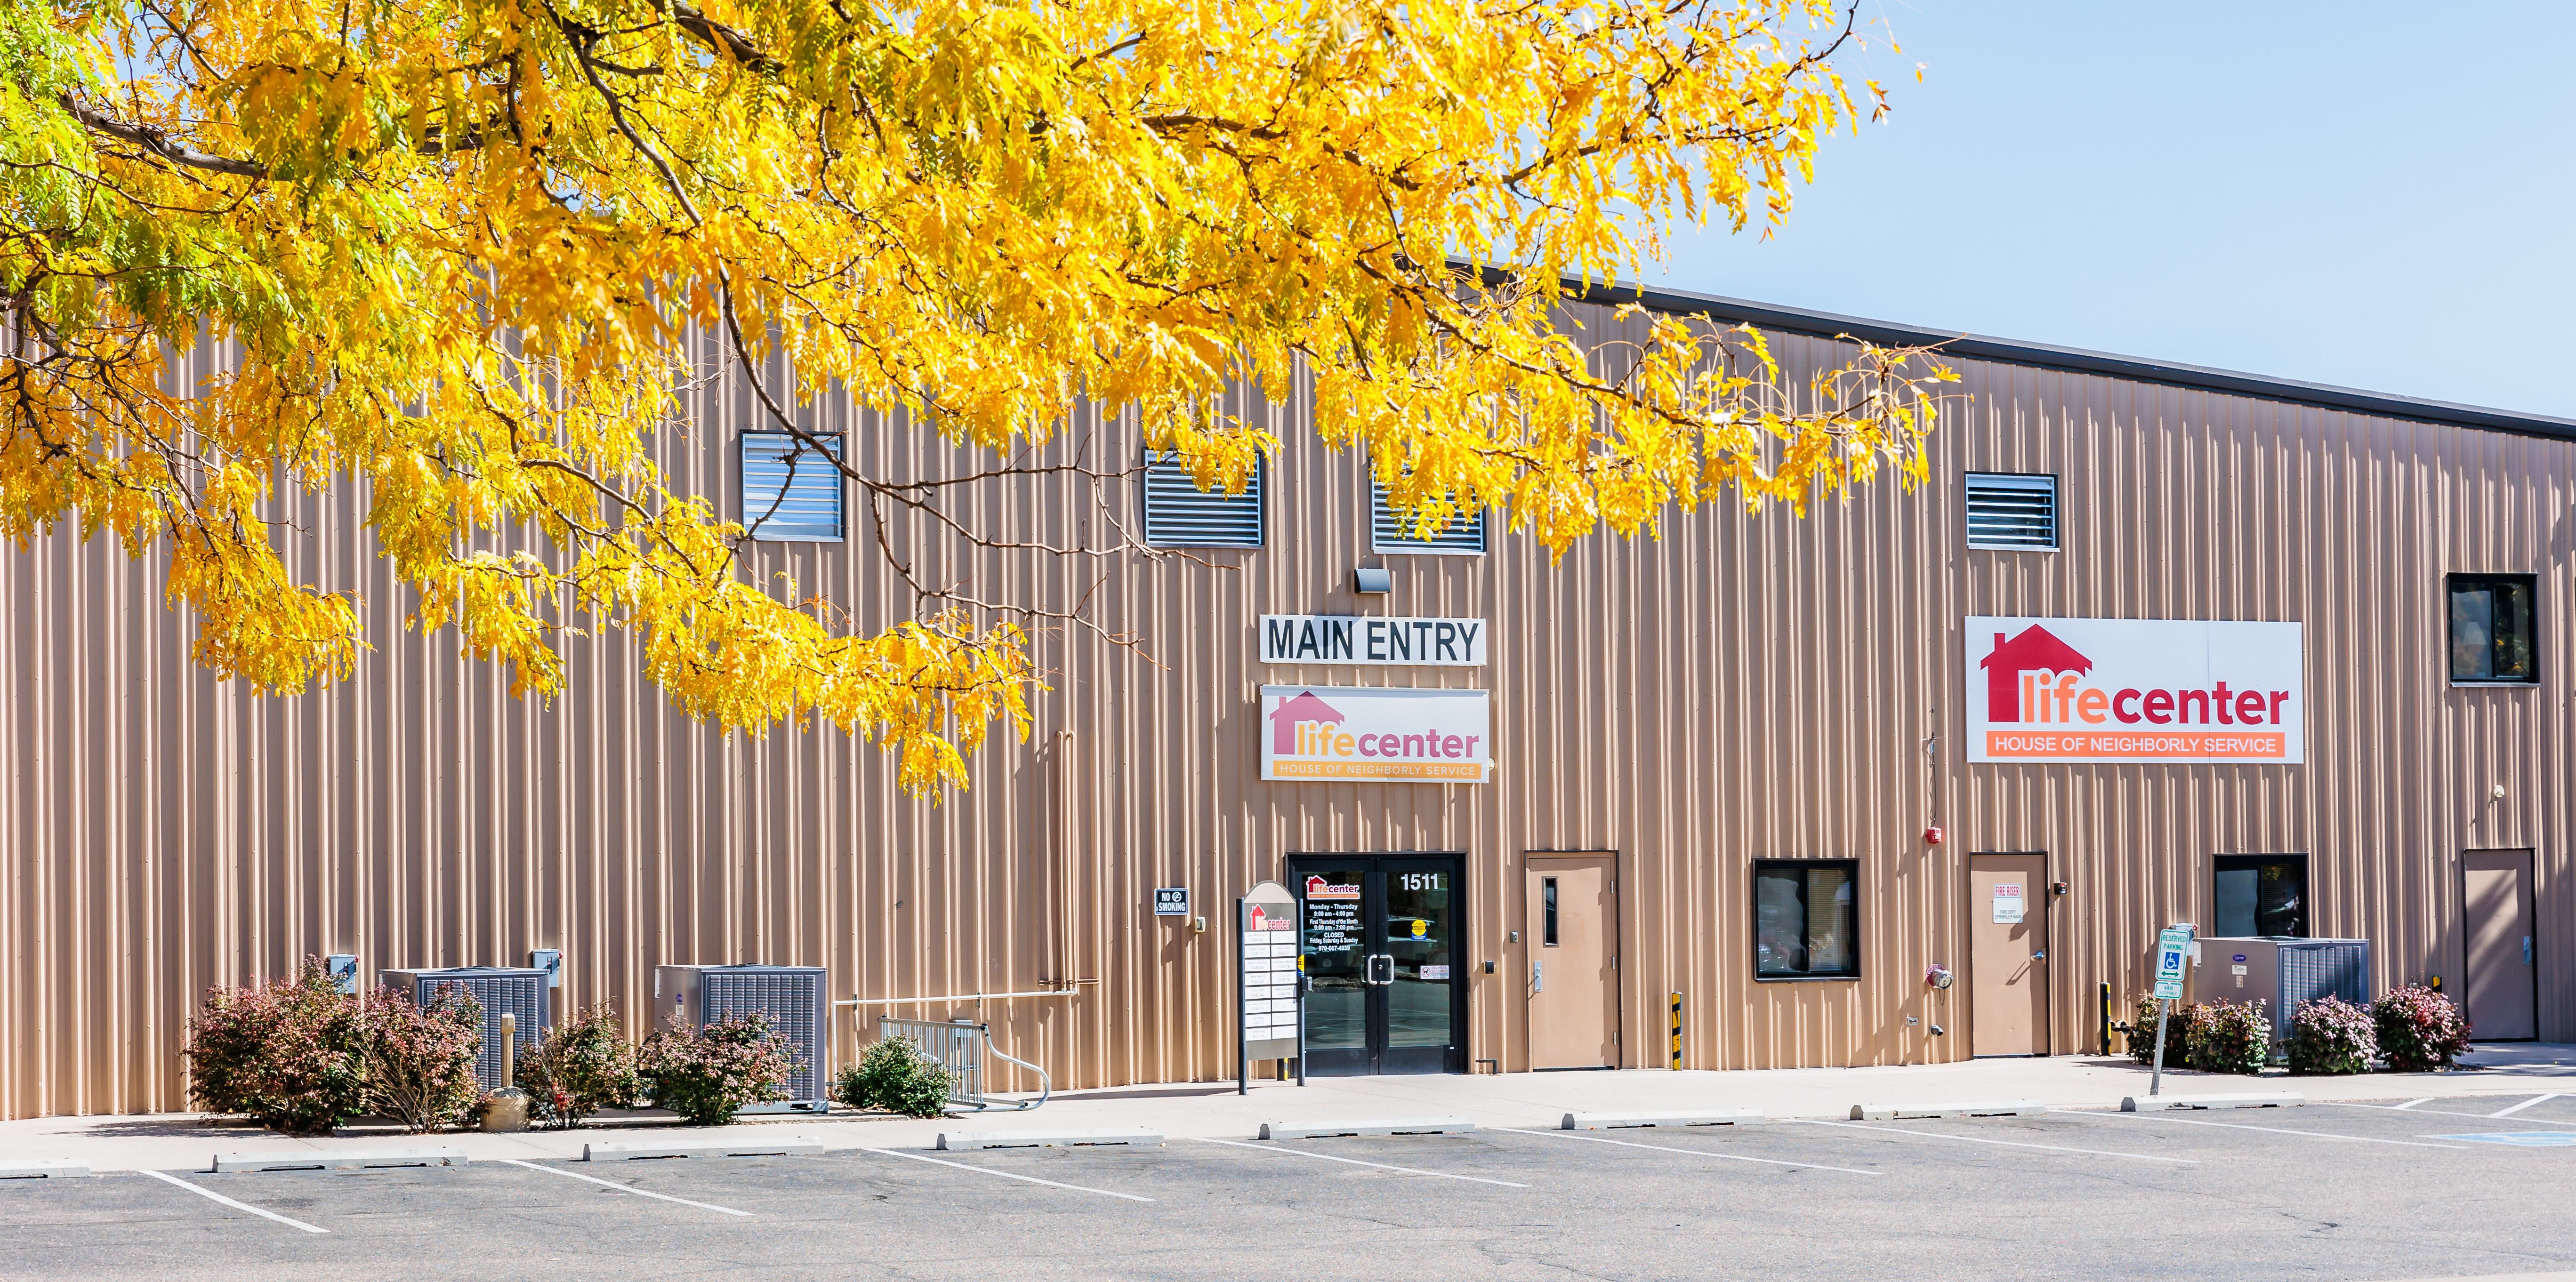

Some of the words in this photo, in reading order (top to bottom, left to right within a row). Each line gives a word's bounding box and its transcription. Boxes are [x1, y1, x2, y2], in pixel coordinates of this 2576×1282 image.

[1269, 619, 1353, 660] MAIN
[1367, 621, 1479, 661] ENTRY
[1996, 737, 2057, 752] HOUSE
[2062, 737, 2085, 752] OF
[2091, 737, 2200, 752] NEIGHBORLY
[2204, 738, 2276, 753] SERVICE
[1280, 764, 1321, 774] HOUSE
[1326, 764, 1342, 774] OF
[1347, 765, 1421, 775] NEIGHBORLY
[1426, 766, 1475, 776] SERVICE
[1401, 873, 1439, 890] 1511
[1161, 892, 1170, 902] NO
[1996, 886, 2005, 896] FIRE
[2006, 886, 2019, 896] RISER
[1158, 902, 1186, 912] SMOKING
